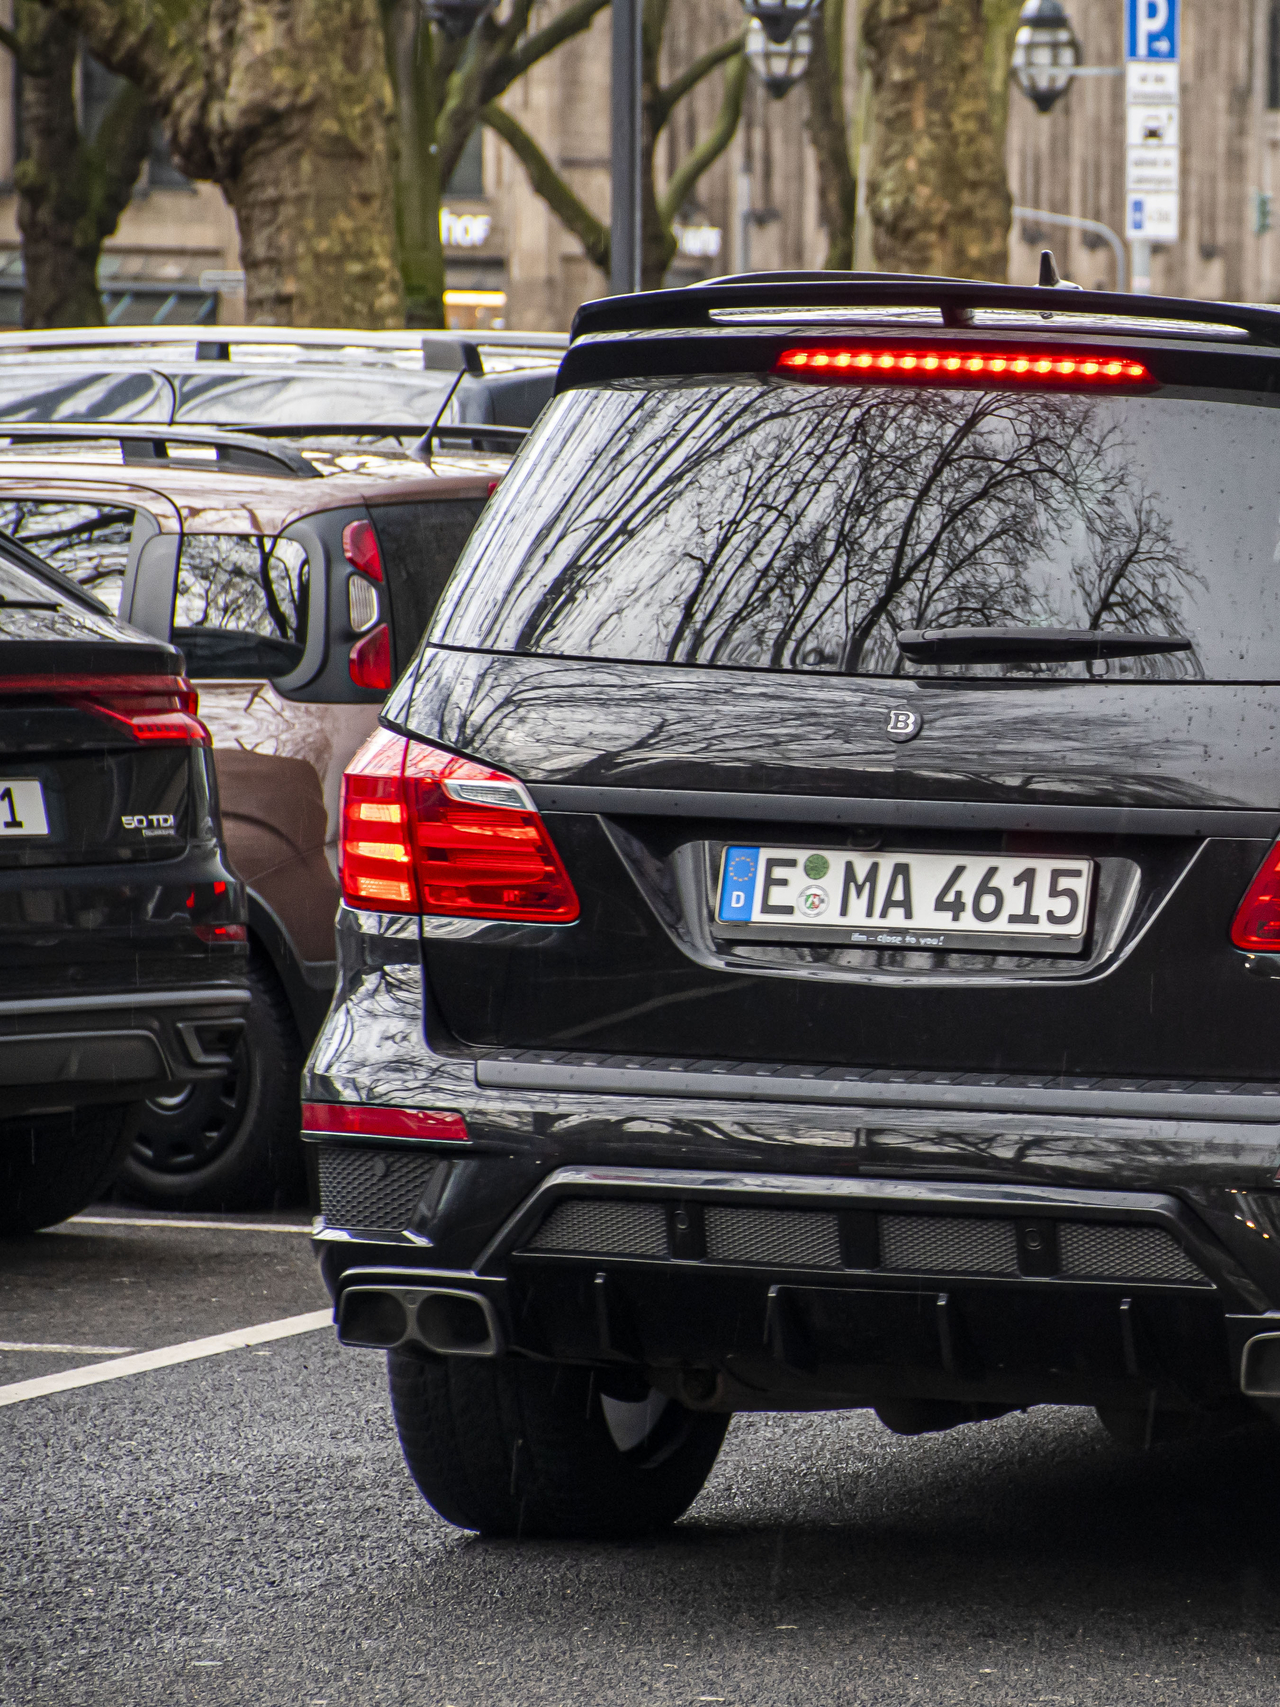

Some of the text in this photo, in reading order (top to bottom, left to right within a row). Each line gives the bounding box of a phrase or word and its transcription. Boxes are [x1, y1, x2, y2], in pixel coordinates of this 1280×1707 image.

[1136, 0, 1169, 57] P
[887, 710, 915, 733] B
[0, 787, 25, 828] 1
[121, 813, 174, 829] 50 TDI
[730, 892, 745, 908] D
[760, 857, 1083, 926] E MA 4615
[877, 933, 902, 944] close
[905, 935, 917, 944] to
[919, 935, 945, 946] you!
